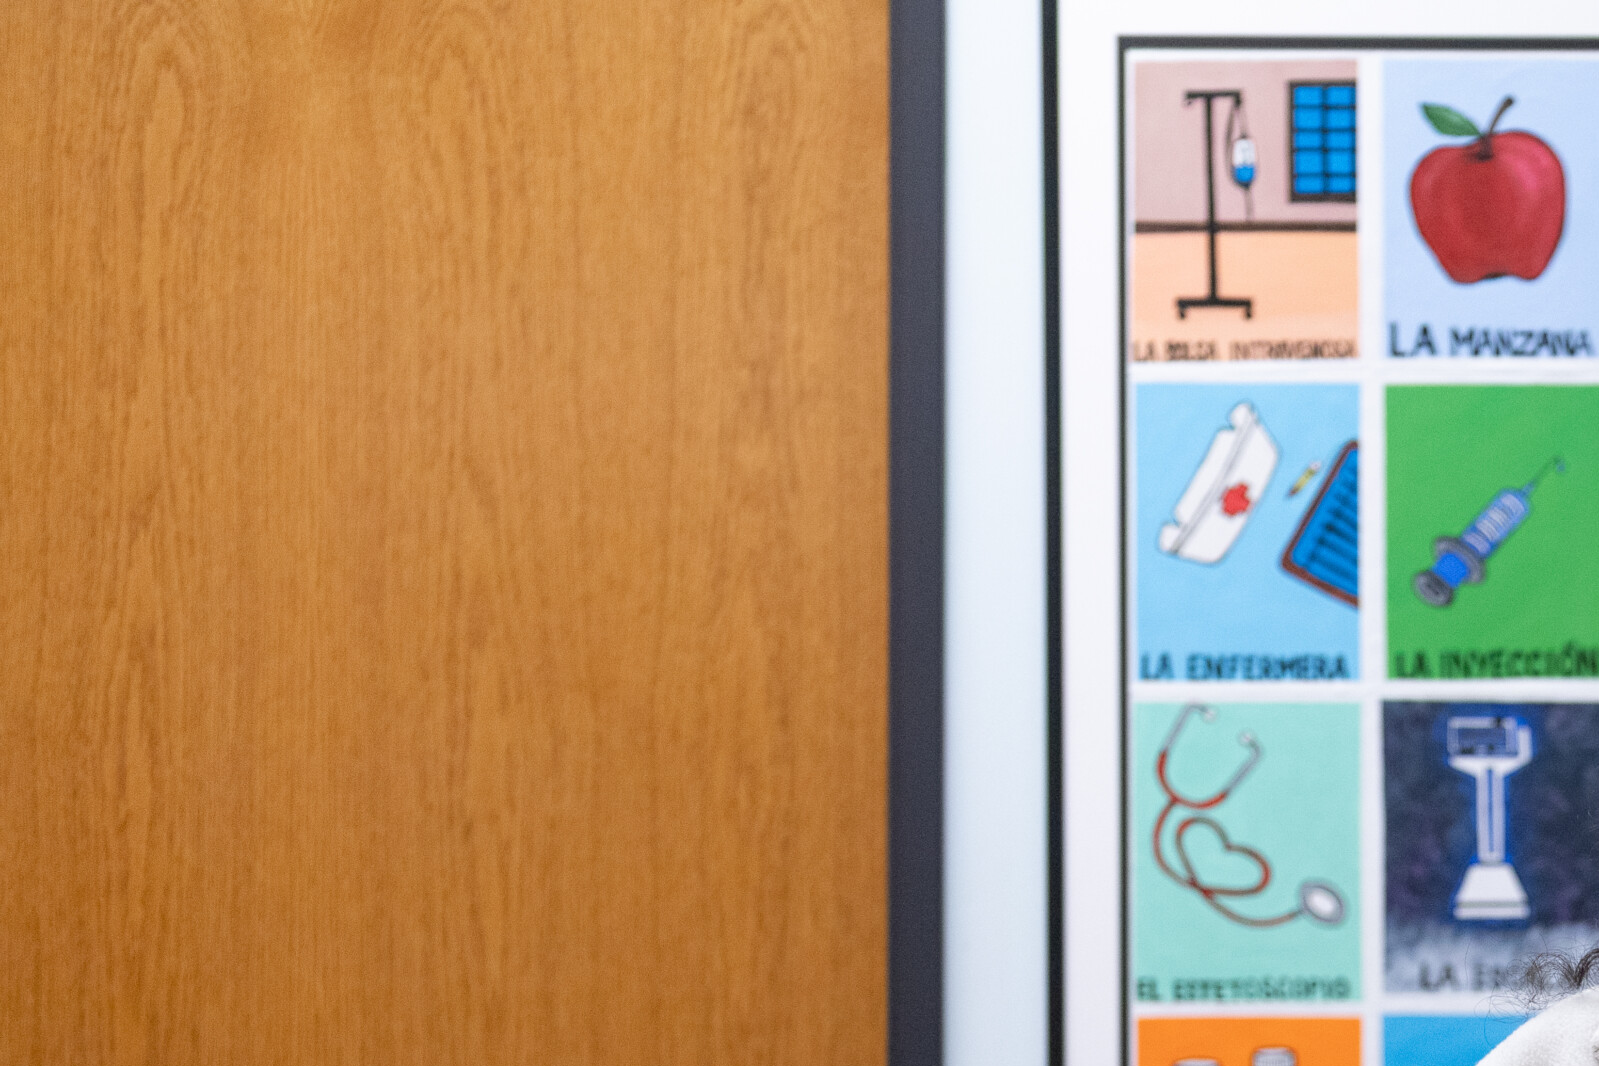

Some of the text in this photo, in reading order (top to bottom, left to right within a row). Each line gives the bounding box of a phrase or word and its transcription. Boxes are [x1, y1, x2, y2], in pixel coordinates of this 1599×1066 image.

[1390, 323, 1594, 357] LA MANZANA
[1141, 653, 1350, 679] LA ENFERMERA
[1396, 650, 1428, 678] LA
[1138, 977, 1160, 1000] EL
[1419, 962, 1459, 992] LA
